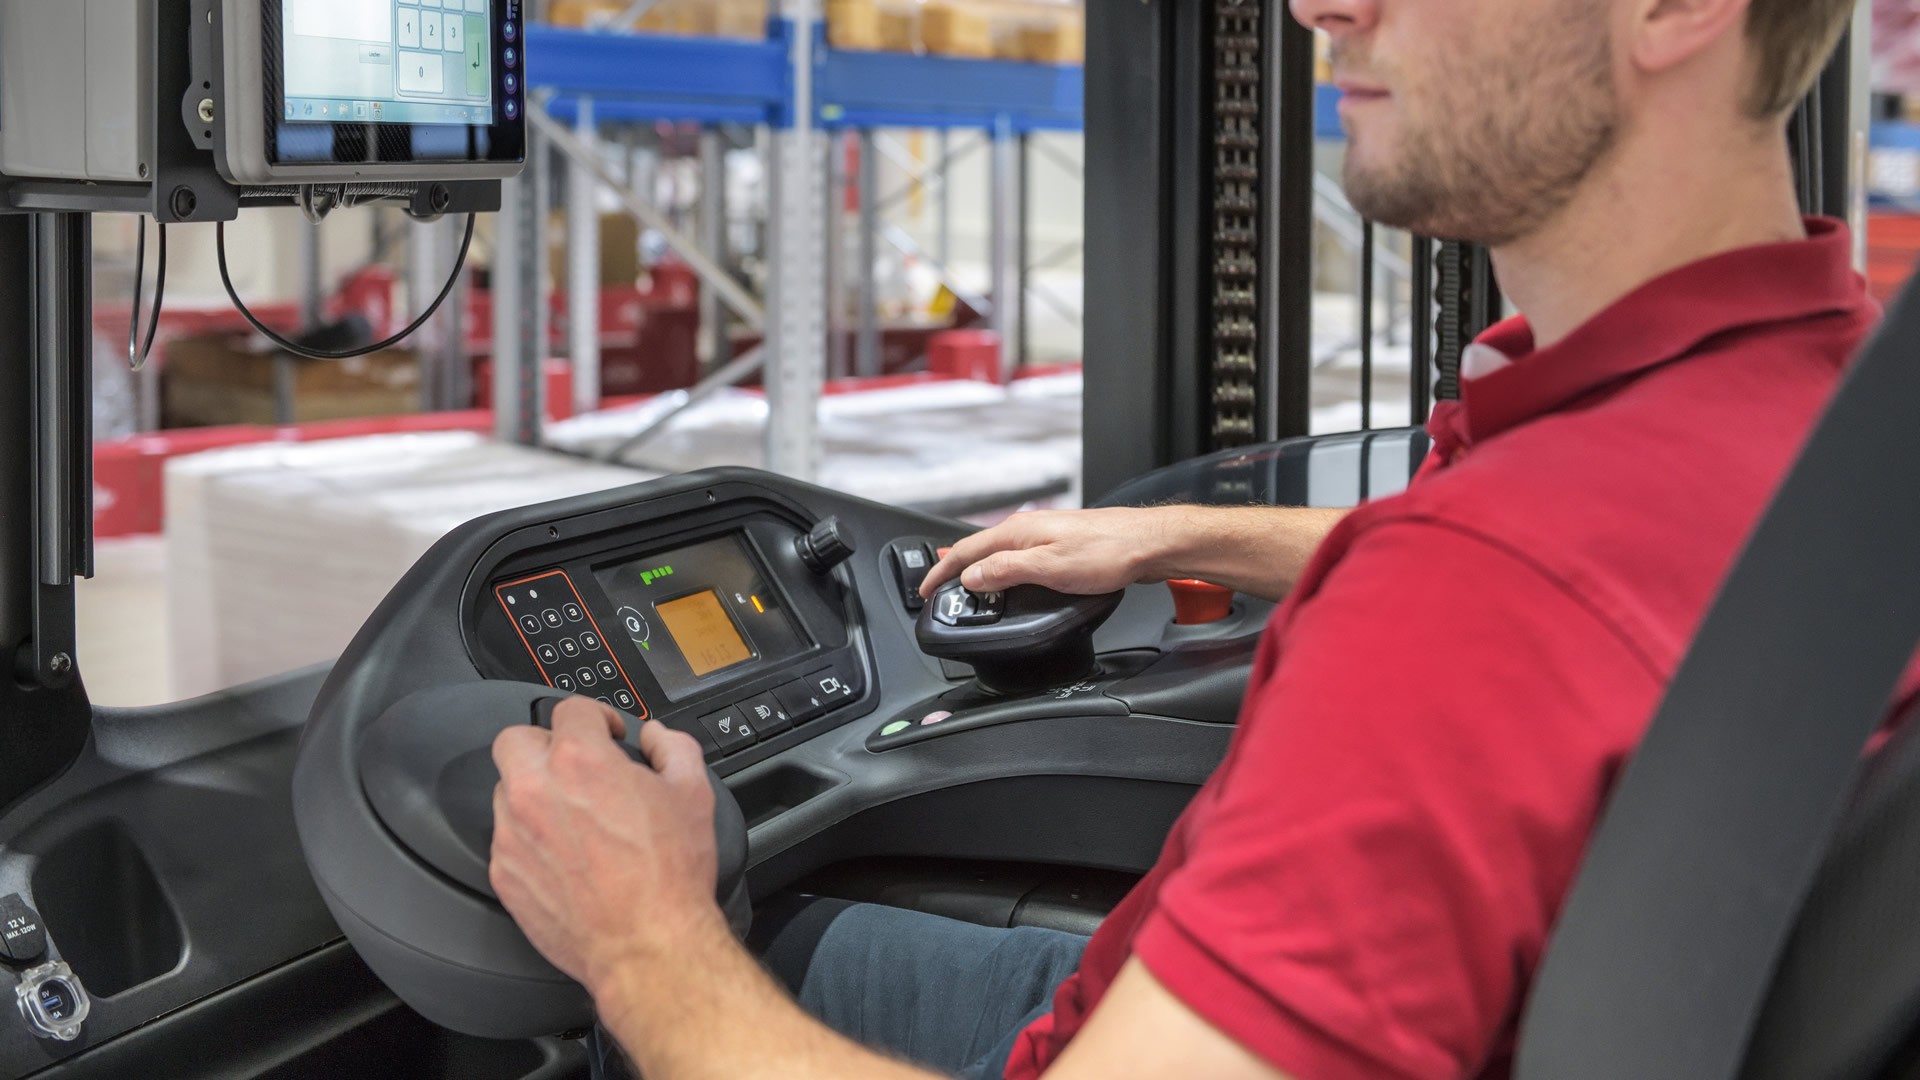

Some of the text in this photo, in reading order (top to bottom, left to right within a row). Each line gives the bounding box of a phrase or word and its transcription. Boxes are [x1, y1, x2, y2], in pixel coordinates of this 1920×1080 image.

[406, 22, 456, 38] 1 2 3
[418, 66, 424, 78] 0
[527, 608, 578, 628] 1 2 3
[545, 637, 595, 658] 4 5 6
[562, 665, 611, 688] 7 8 9
[7, 916, 25, 929] 12 V
